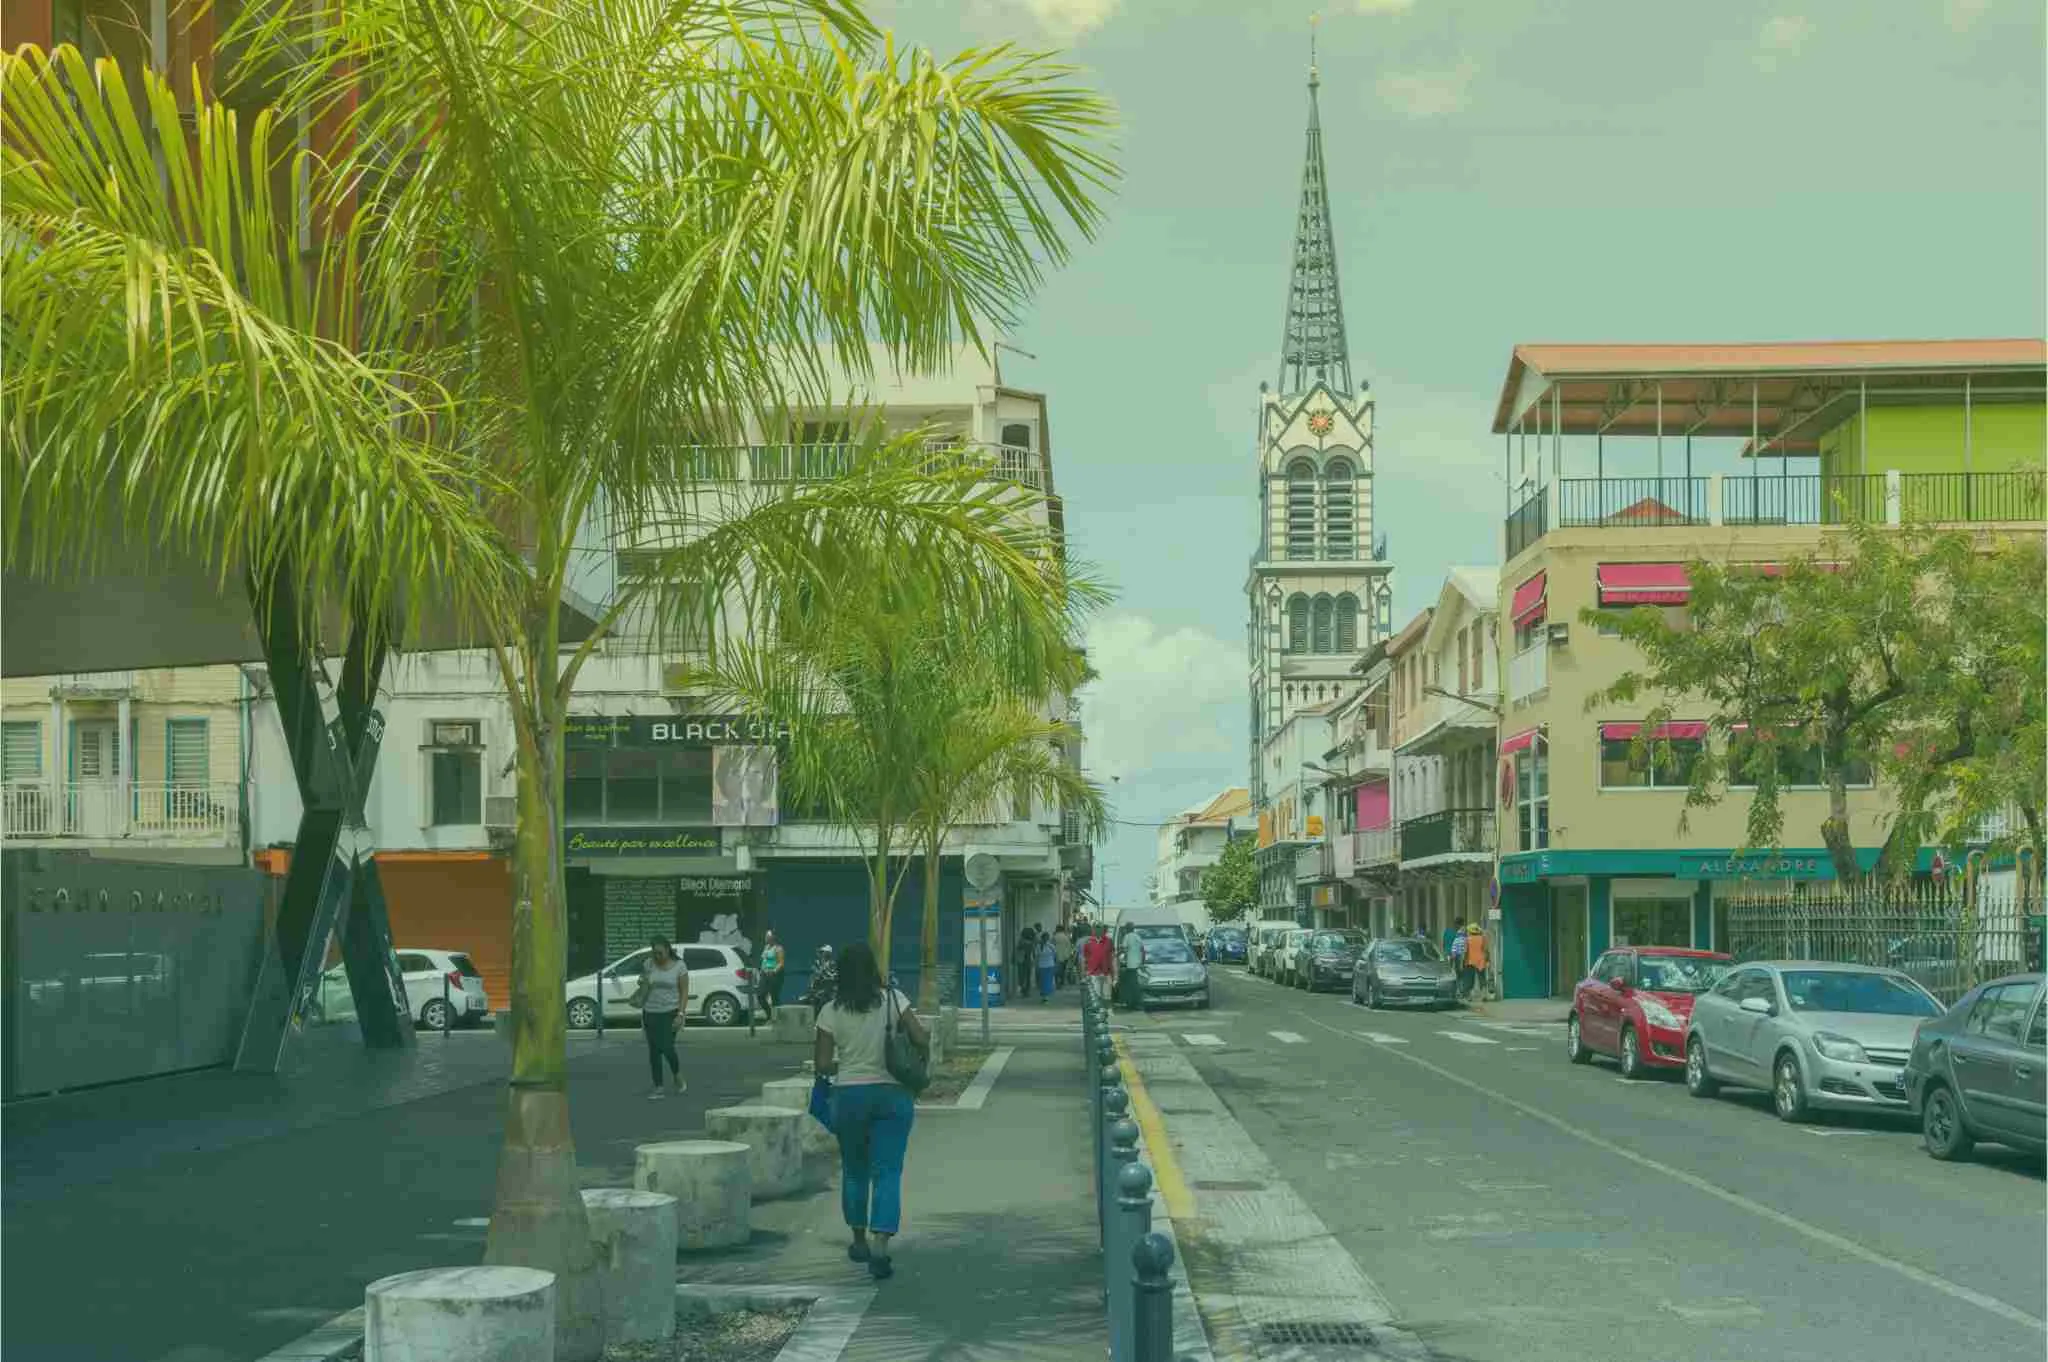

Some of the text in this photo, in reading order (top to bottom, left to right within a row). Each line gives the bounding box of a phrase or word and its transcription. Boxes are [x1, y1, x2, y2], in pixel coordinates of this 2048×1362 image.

[651, 722, 740, 741] BLACK
[617, 838, 648, 856] par
[649, 833, 718, 849] excellence
[680, 877, 752, 890] Black Diamond
